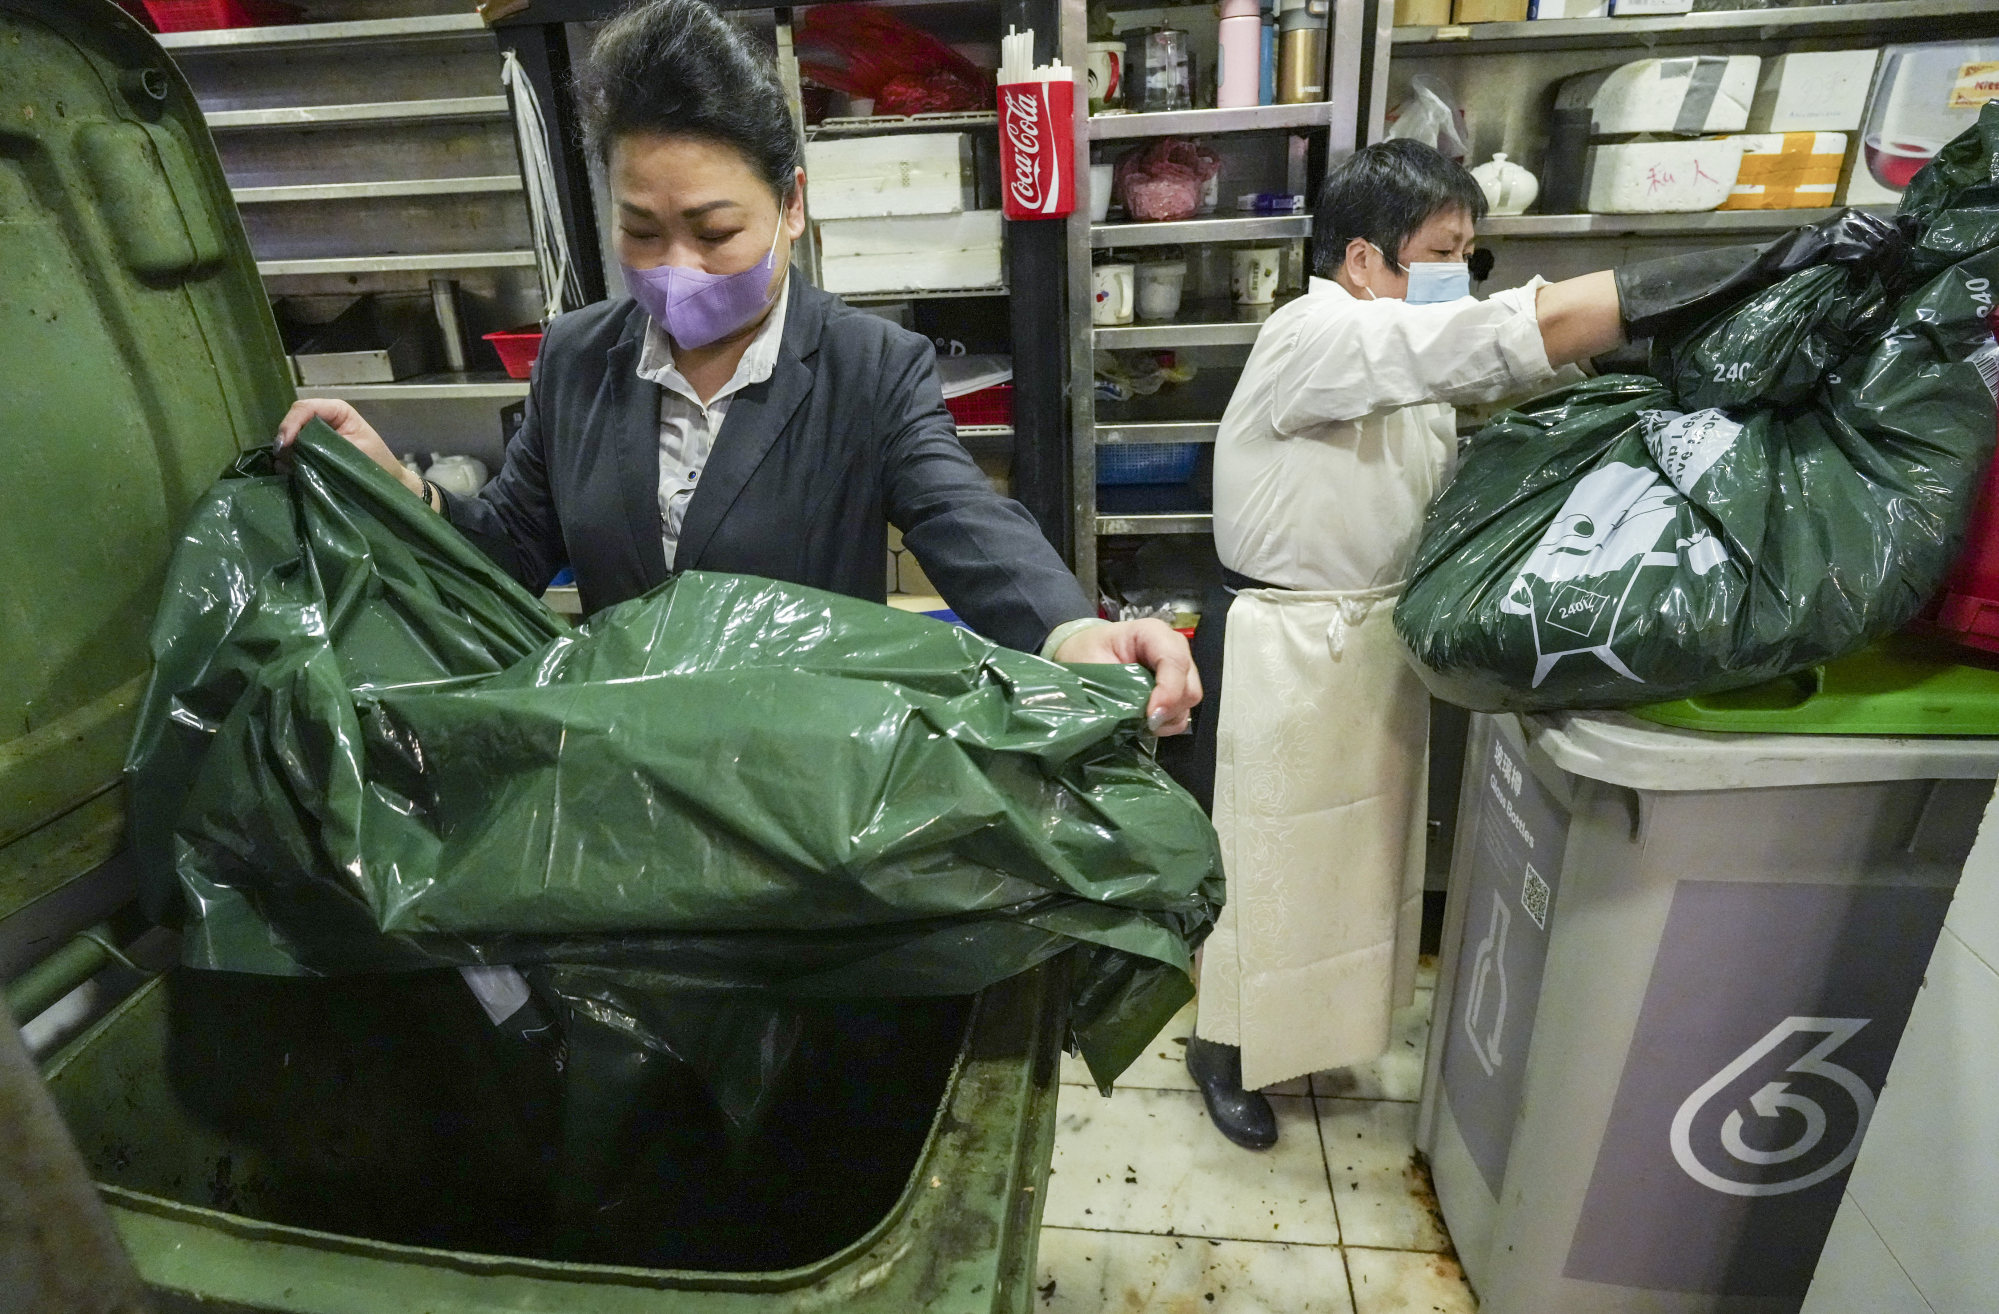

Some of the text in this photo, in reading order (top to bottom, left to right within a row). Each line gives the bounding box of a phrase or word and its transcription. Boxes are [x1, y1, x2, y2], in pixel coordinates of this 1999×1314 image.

[1005, 89, 1041, 209] Coca-Cola
[1675, 451, 1693, 485] ave
[1506, 800, 1535, 849] Bottles
